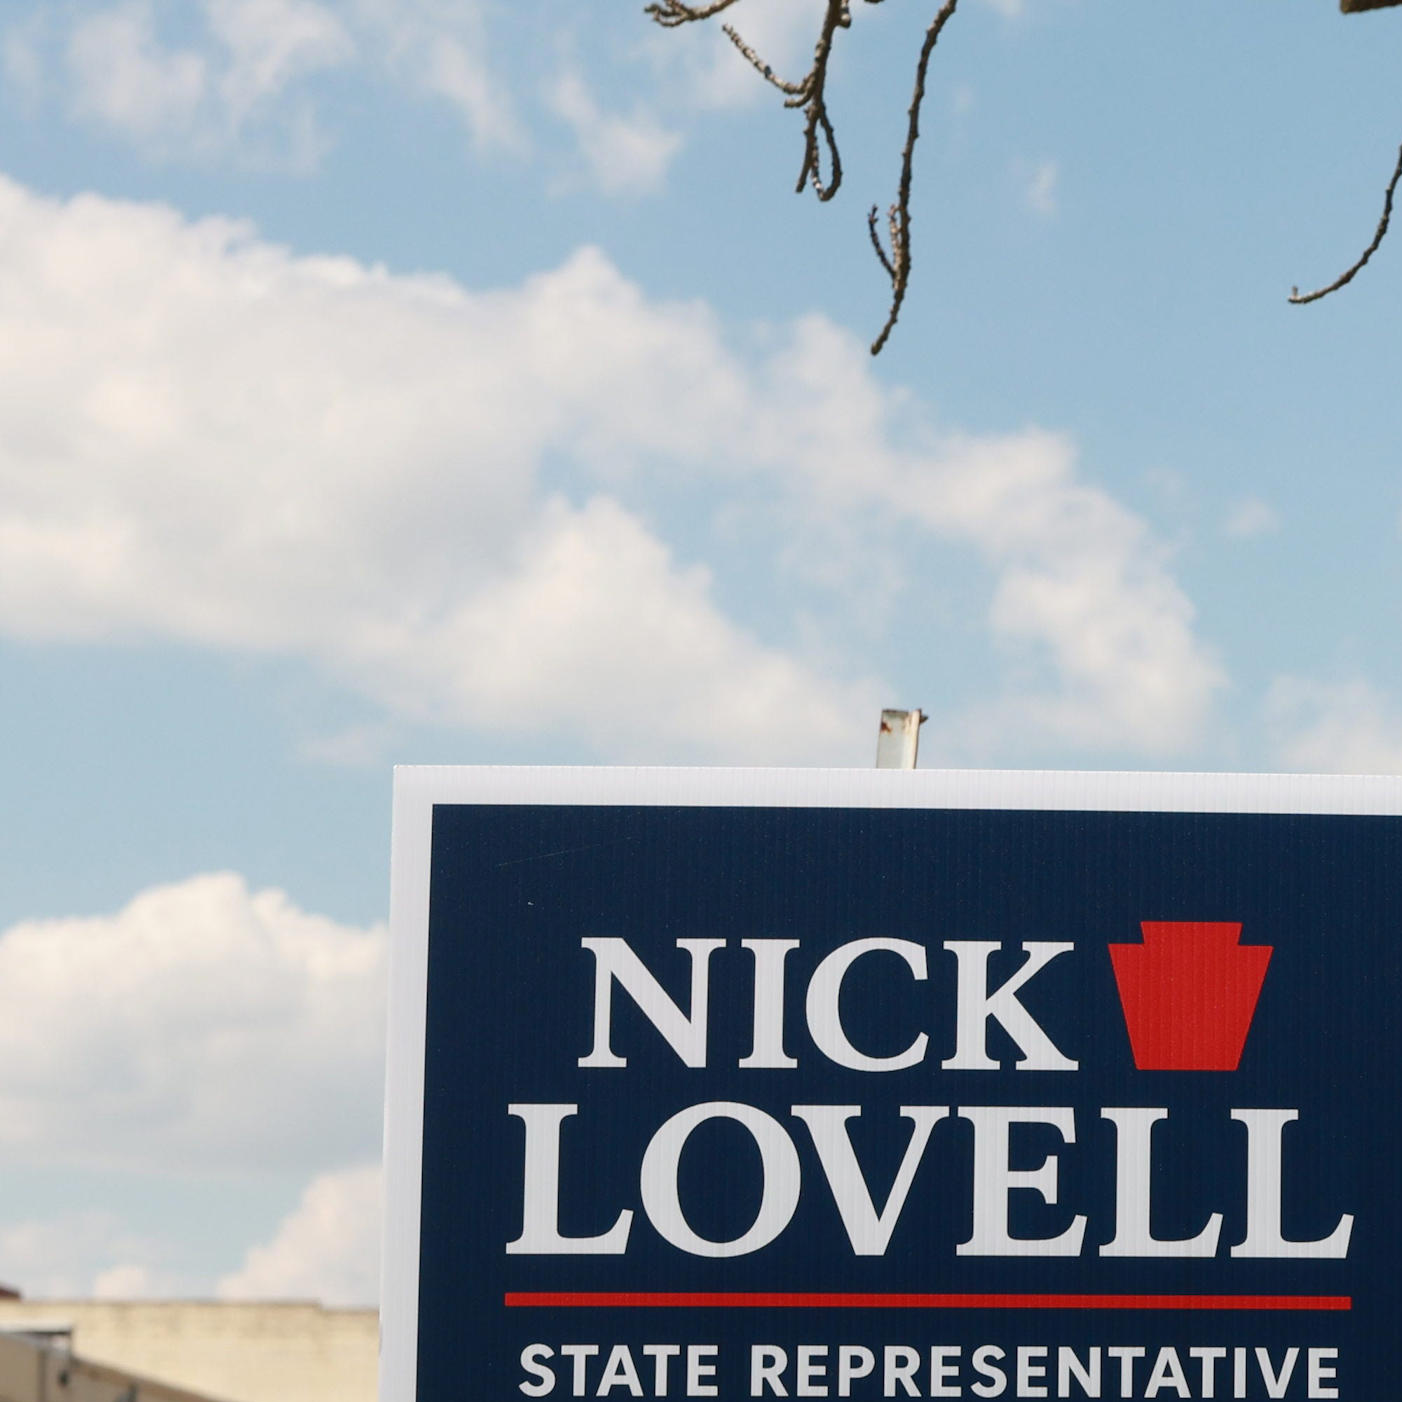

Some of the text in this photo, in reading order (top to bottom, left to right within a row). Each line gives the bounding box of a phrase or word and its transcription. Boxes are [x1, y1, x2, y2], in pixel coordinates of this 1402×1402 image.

[578, 937, 1078, 1071] NICK
[506, 1102, 1354, 1258] LOVELL
[519, 1344, 1338, 1398] STATE REPRESENTATIVE
